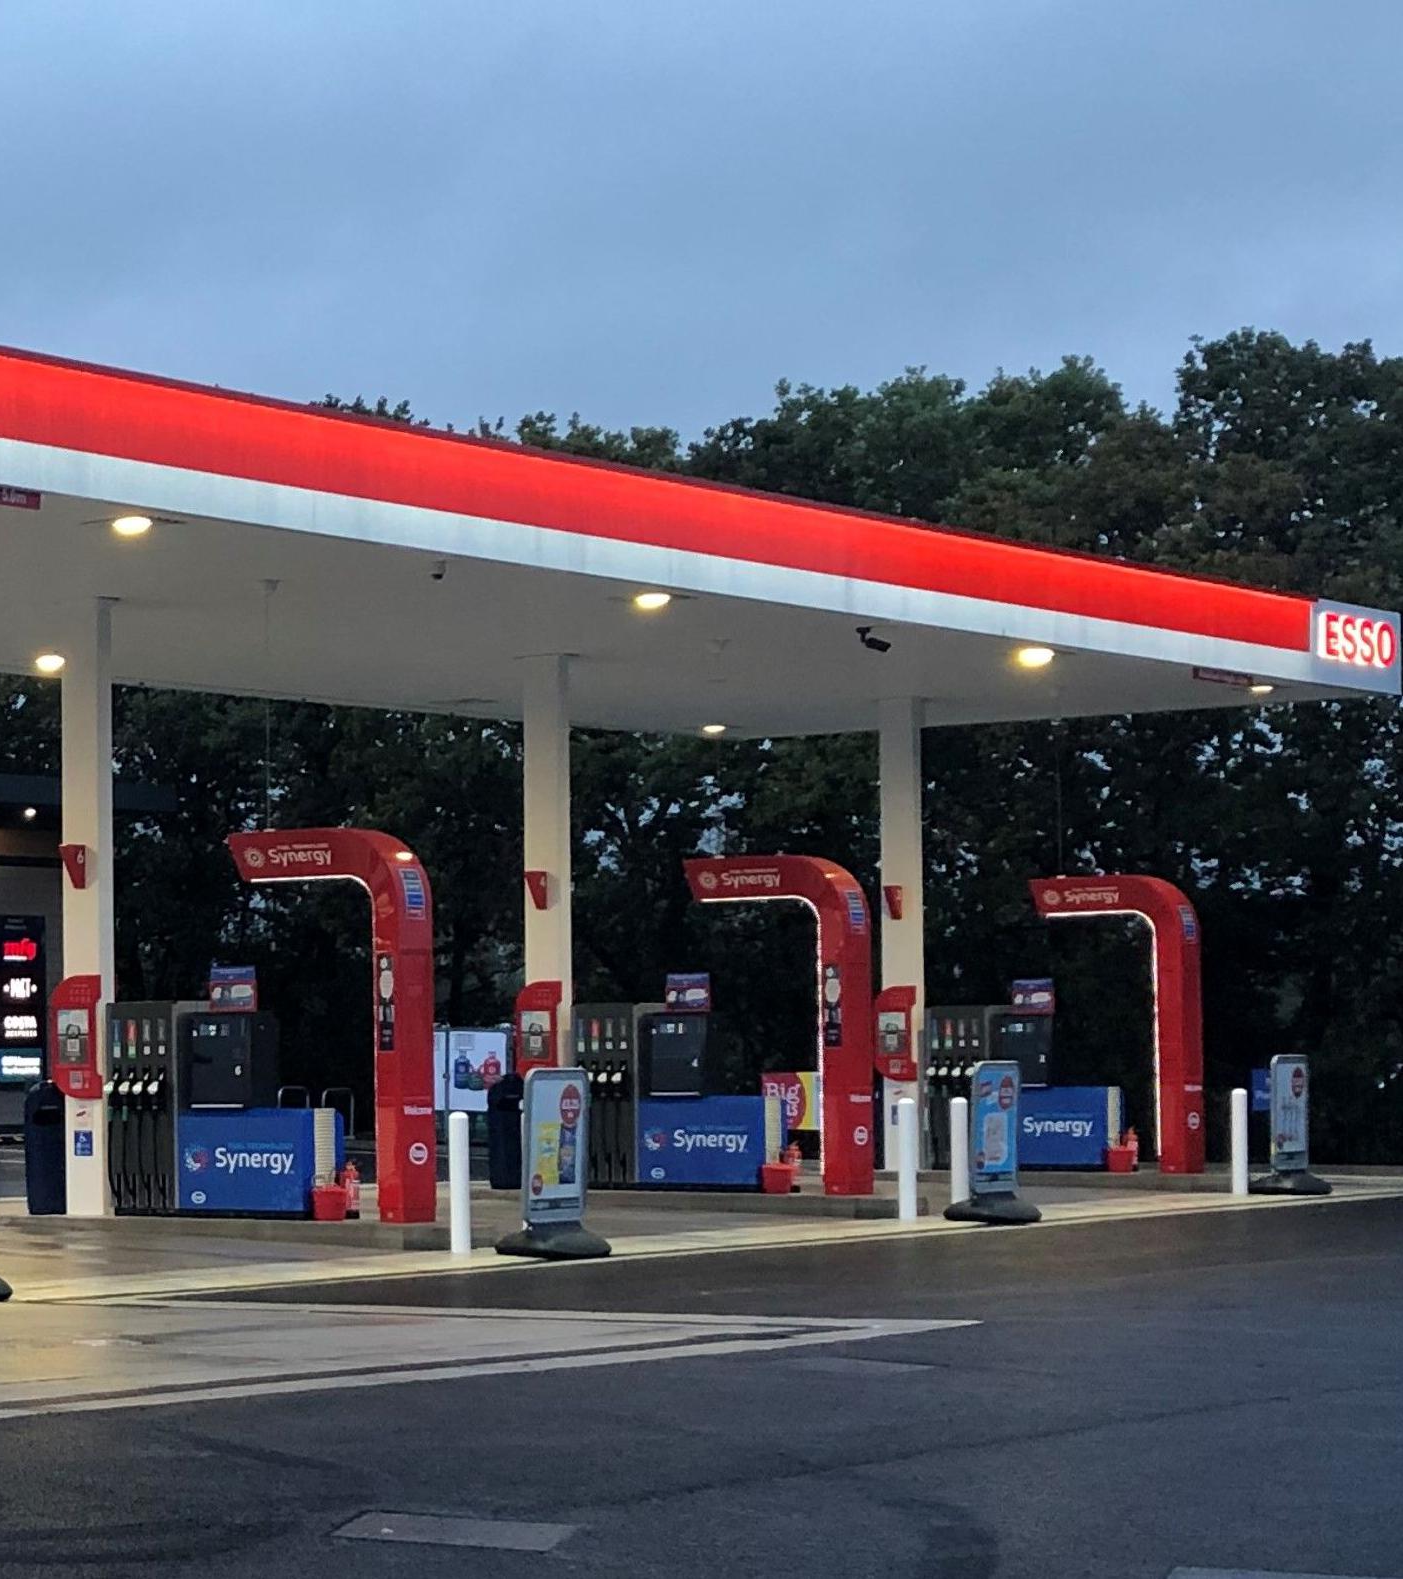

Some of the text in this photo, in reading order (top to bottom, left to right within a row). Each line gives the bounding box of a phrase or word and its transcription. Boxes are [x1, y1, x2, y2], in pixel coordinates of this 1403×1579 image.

[1319, 611, 1396, 669] ESSO
[77, 850, 84, 864] 6
[268, 849, 332, 867] Synergy
[720, 872, 781, 888] Synergy
[1064, 889, 1120, 905] Synergy
[764, 1083, 801, 1104] Big
[1022, 1116, 1094, 1137] Synergy
[673, 1128, 749, 1153] Synergy
[215, 1147, 294, 1175] Synergy
